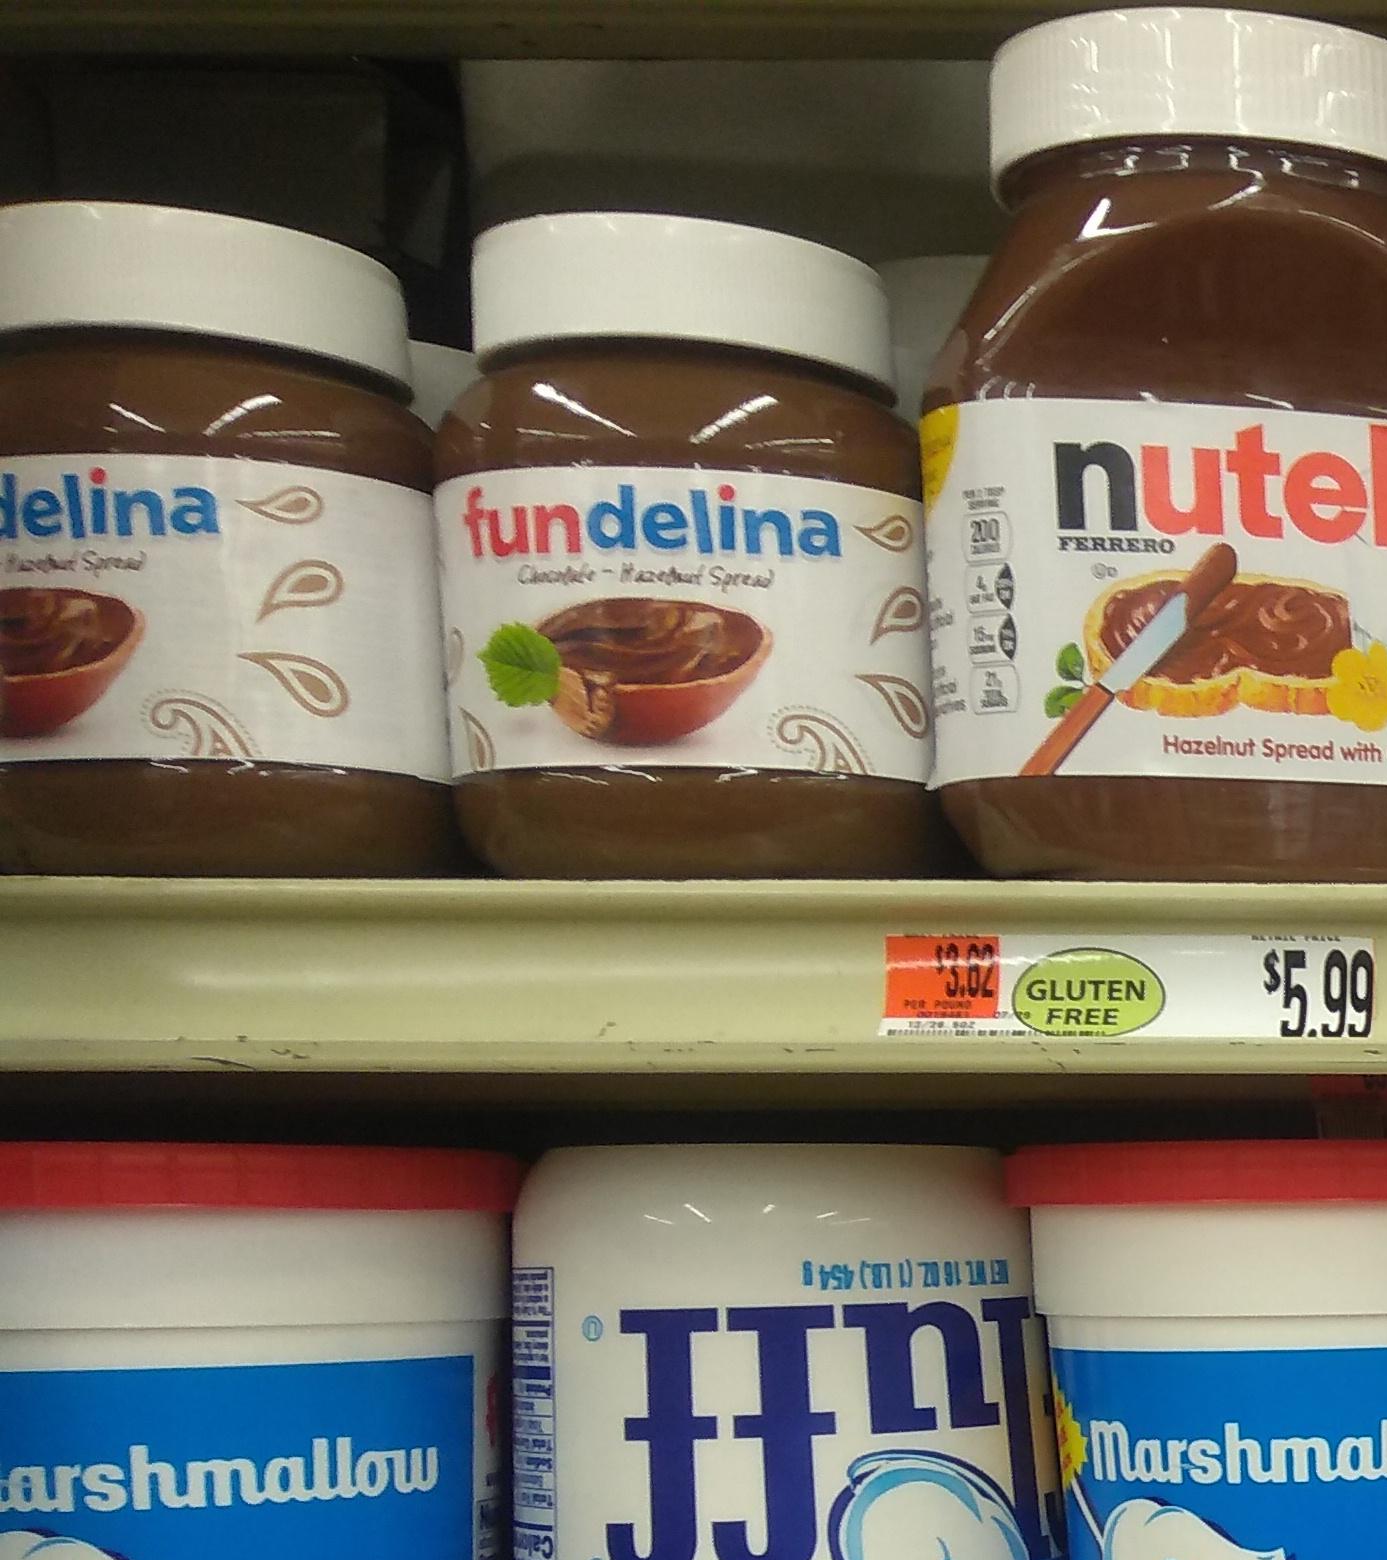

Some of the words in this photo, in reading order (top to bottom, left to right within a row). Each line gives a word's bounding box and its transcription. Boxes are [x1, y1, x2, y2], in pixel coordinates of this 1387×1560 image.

[464, 484, 842, 557] fundelina
[1057, 537, 1175, 555] FERRERO
[708, 565, 776, 592] Spread
[1163, 736, 1256, 759] Hazelnut
[1262, 738, 1334, 764] Spread
[1340, 743, 1384, 763] with
[1026, 979, 1145, 1002] GLUTEN
[1263, 949, 1374, 1038] $5.99
[1046, 1008, 1118, 1026] FREE
